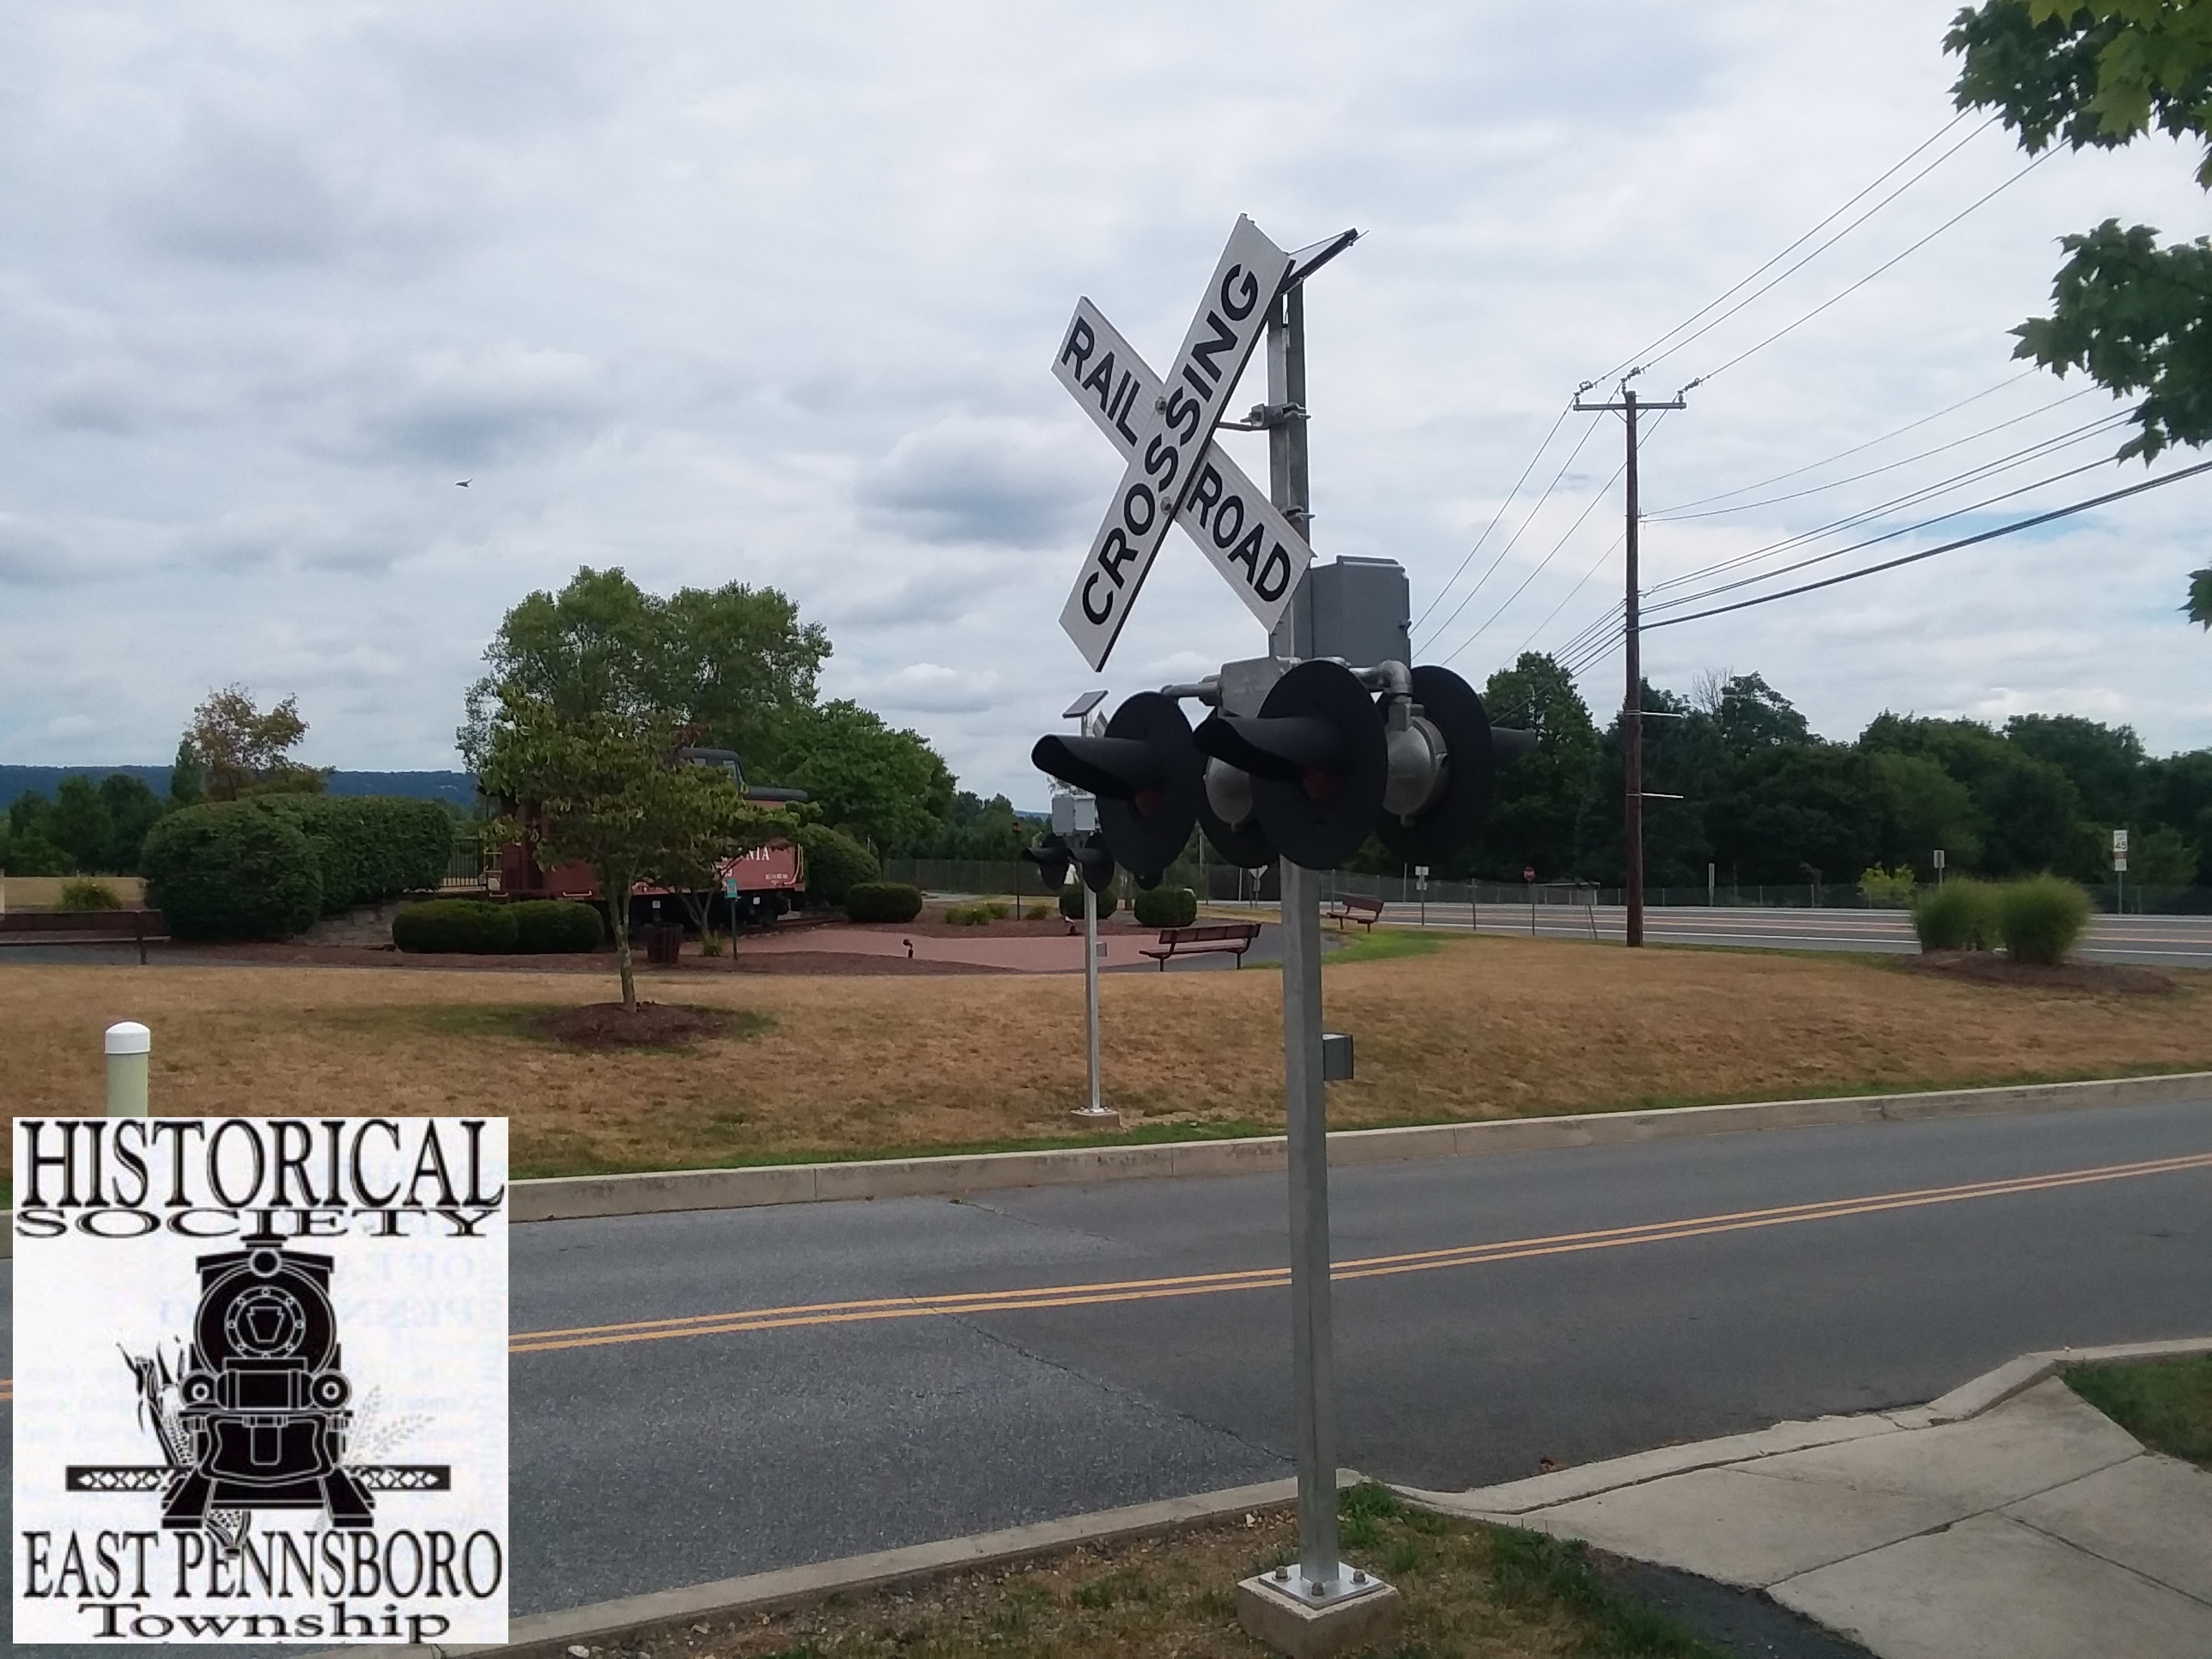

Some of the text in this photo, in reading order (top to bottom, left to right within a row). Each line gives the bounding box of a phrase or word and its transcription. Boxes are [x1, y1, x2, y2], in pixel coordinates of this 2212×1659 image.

[1060, 315, 1291, 603] RAIL ROAD
[1082, 263, 1259, 626] CROSSING
[2115, 842, 2127, 850] 45
